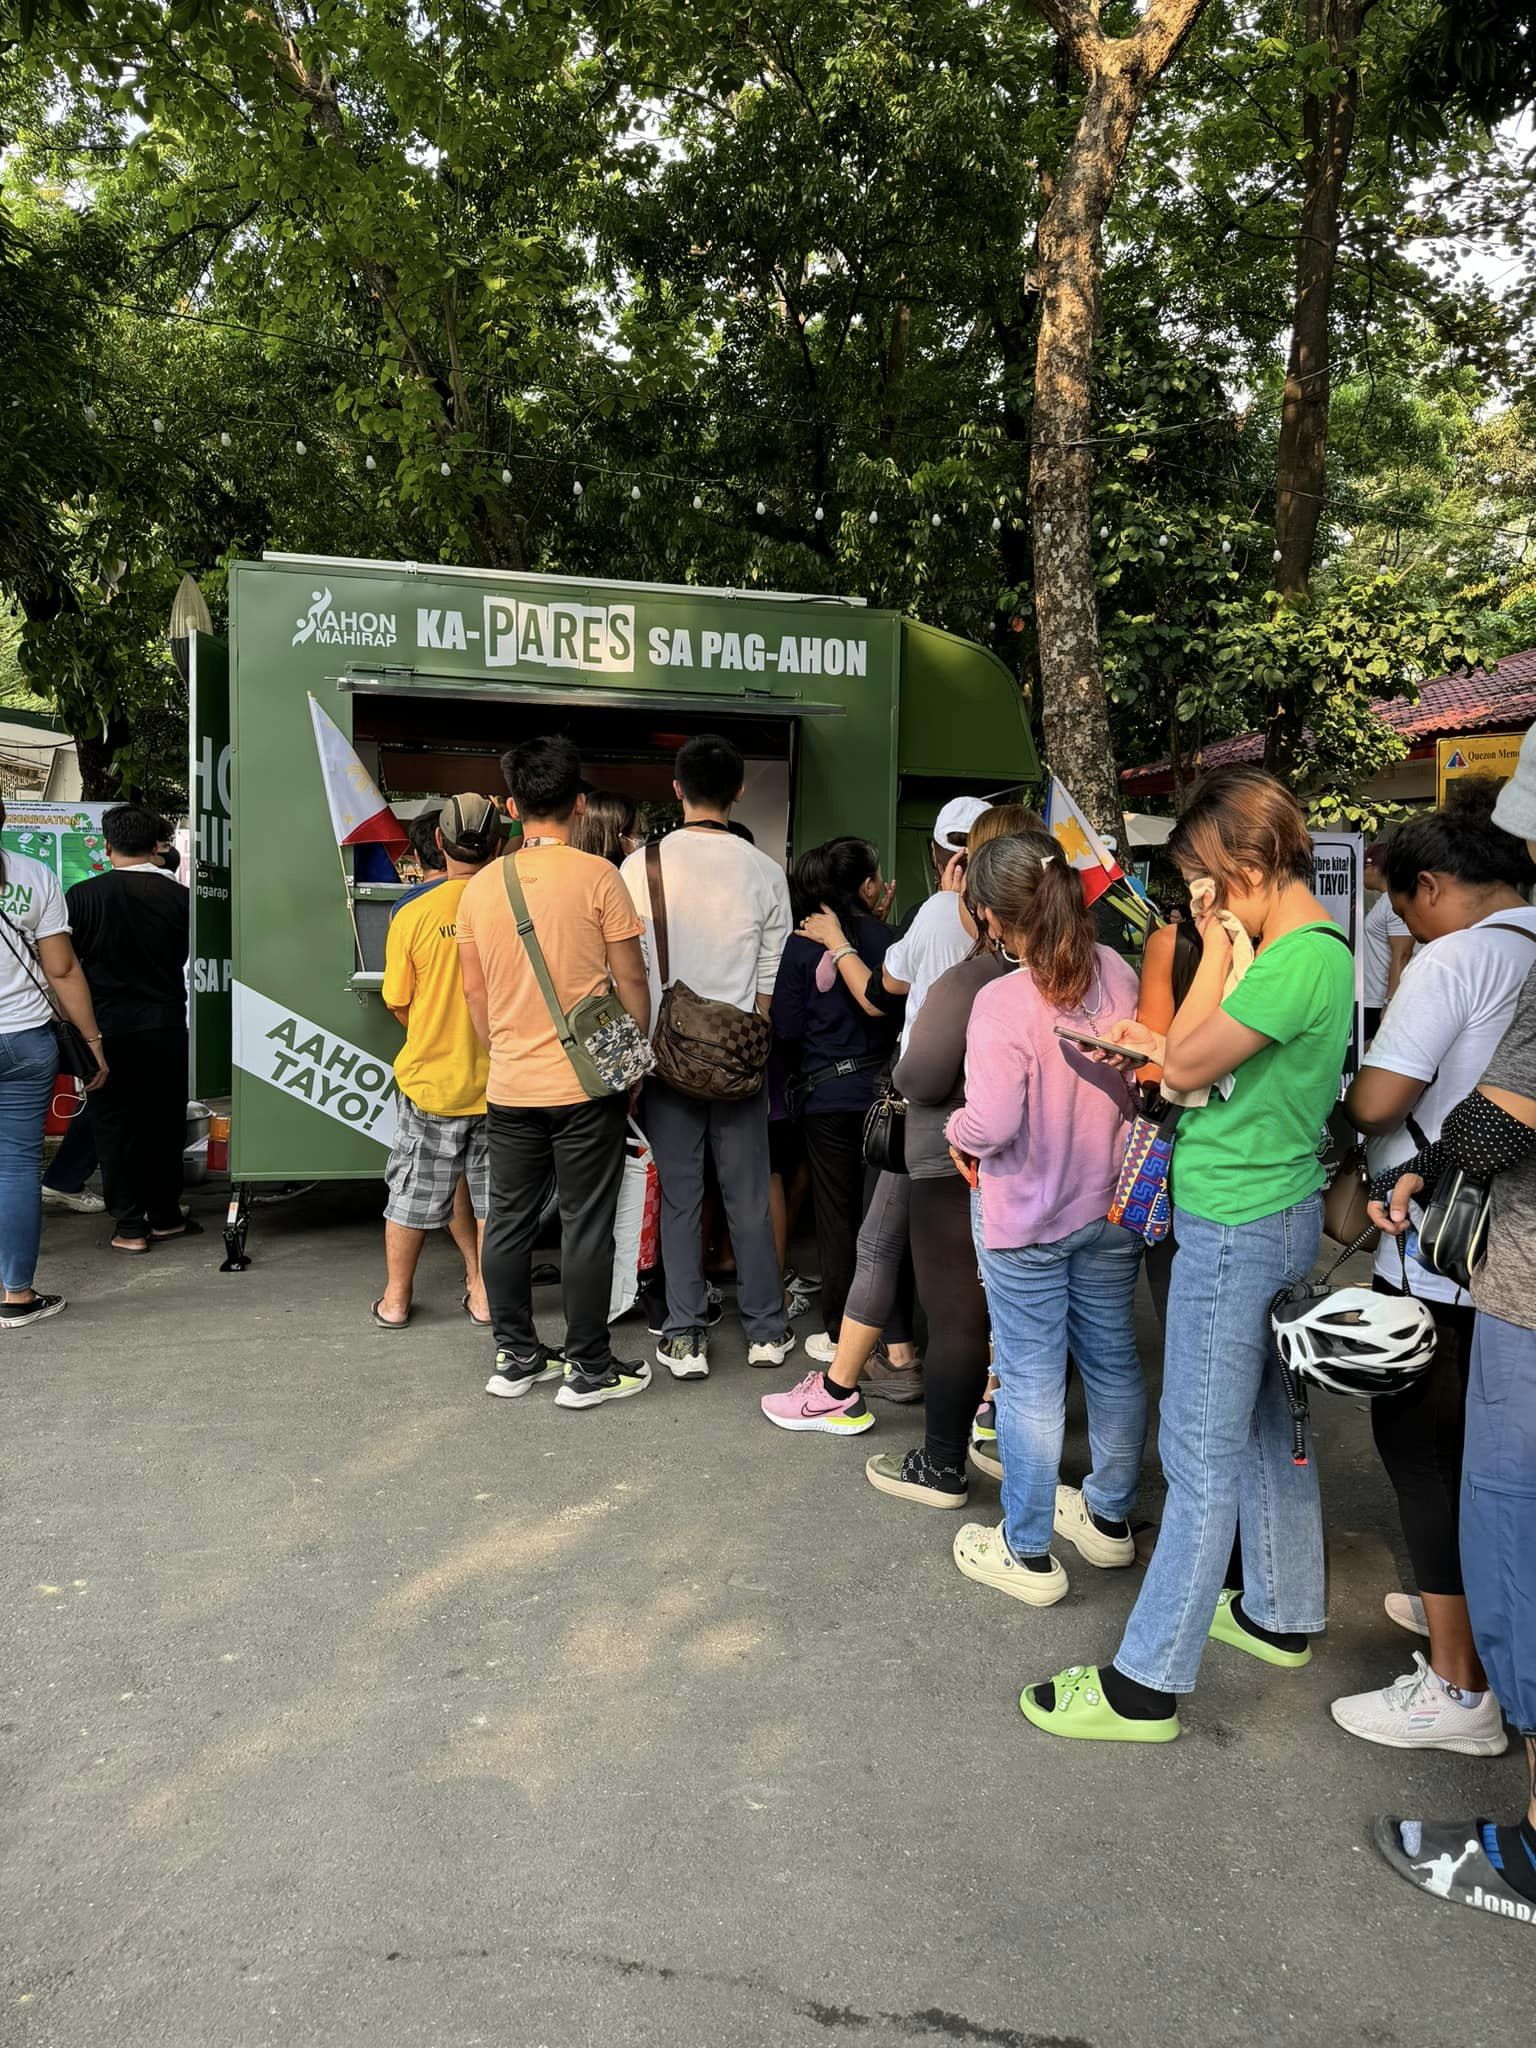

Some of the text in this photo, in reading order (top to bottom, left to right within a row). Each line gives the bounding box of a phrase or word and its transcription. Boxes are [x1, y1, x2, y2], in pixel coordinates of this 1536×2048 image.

[321, 610, 397, 634] AHON
[315, 628, 397, 647] MAHIRAP
[649, 626, 694, 667] SA
[701, 630, 867, 677] PAG-AHON
[1468, 751, 1496, 762] Quezon
[1332, 856, 1349, 871] kita!
[196, 884, 229, 900] ngarap
[1319, 874, 1348, 896] TAYO!
[194, 957, 219, 993] SA
[270, 1050, 384, 1131] TAYO!
